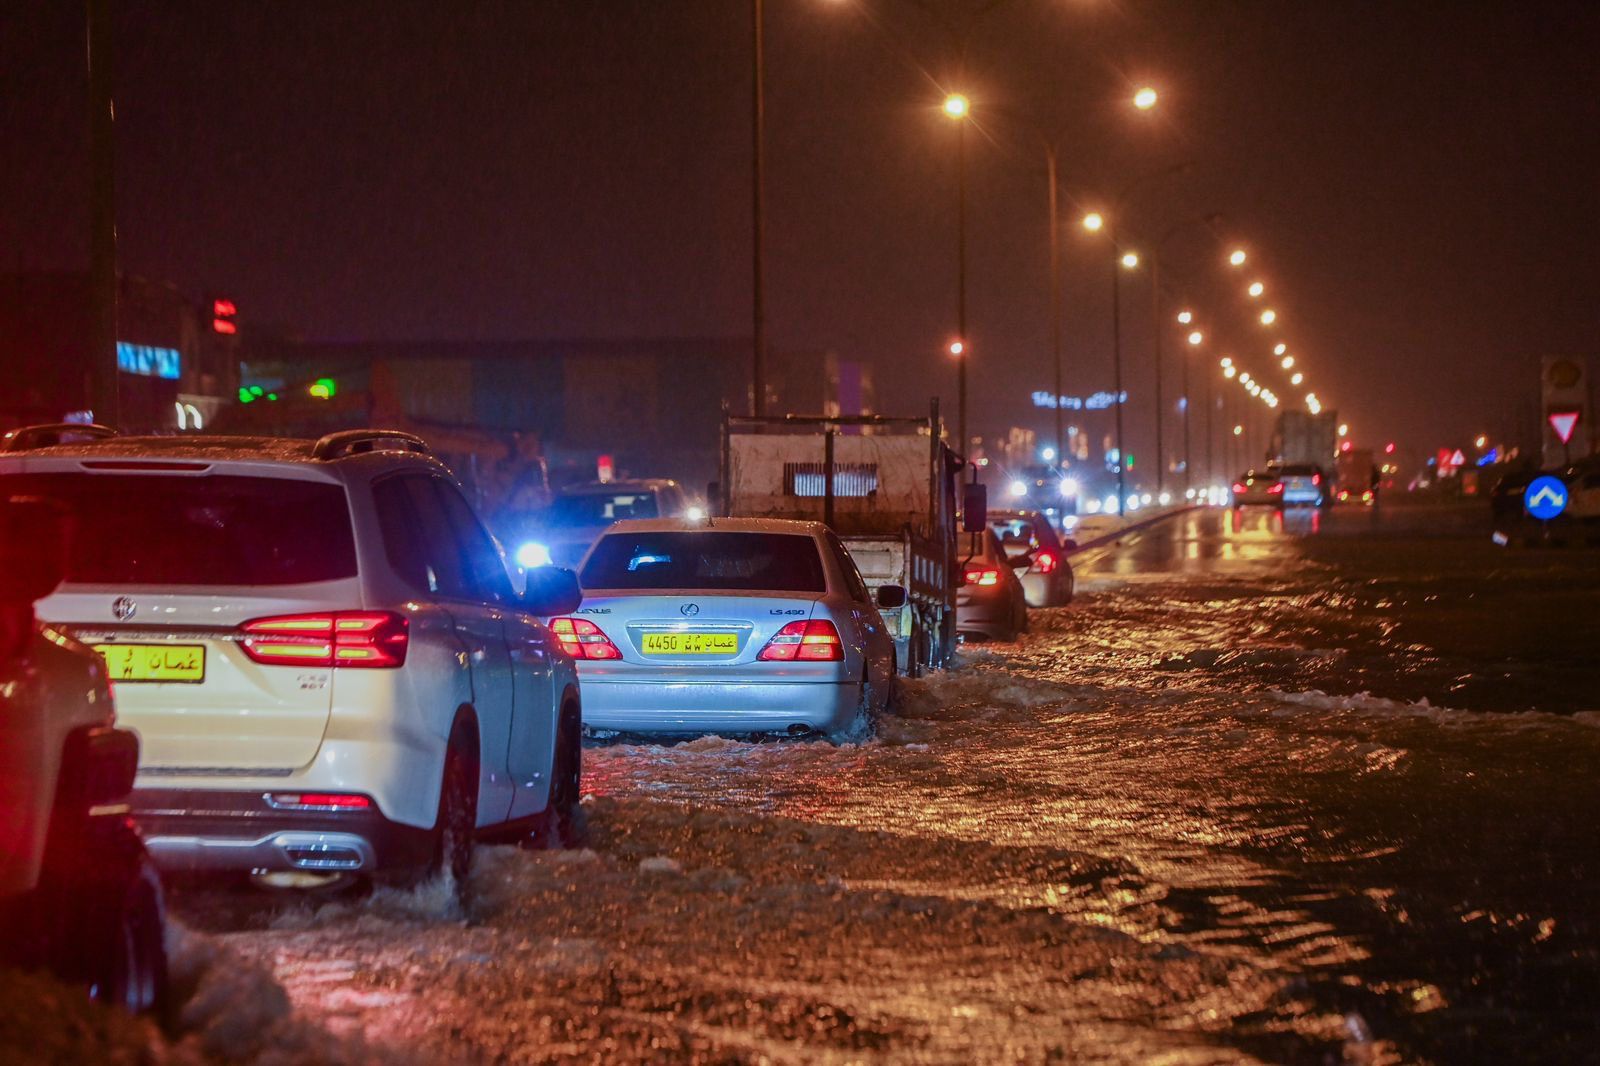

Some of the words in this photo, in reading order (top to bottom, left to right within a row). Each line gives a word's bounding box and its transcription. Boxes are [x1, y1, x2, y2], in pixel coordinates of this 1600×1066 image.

[649, 636, 677, 650] 4450
[705, 637, 735, 648] عمان
[149, 651, 198, 670] عمان
